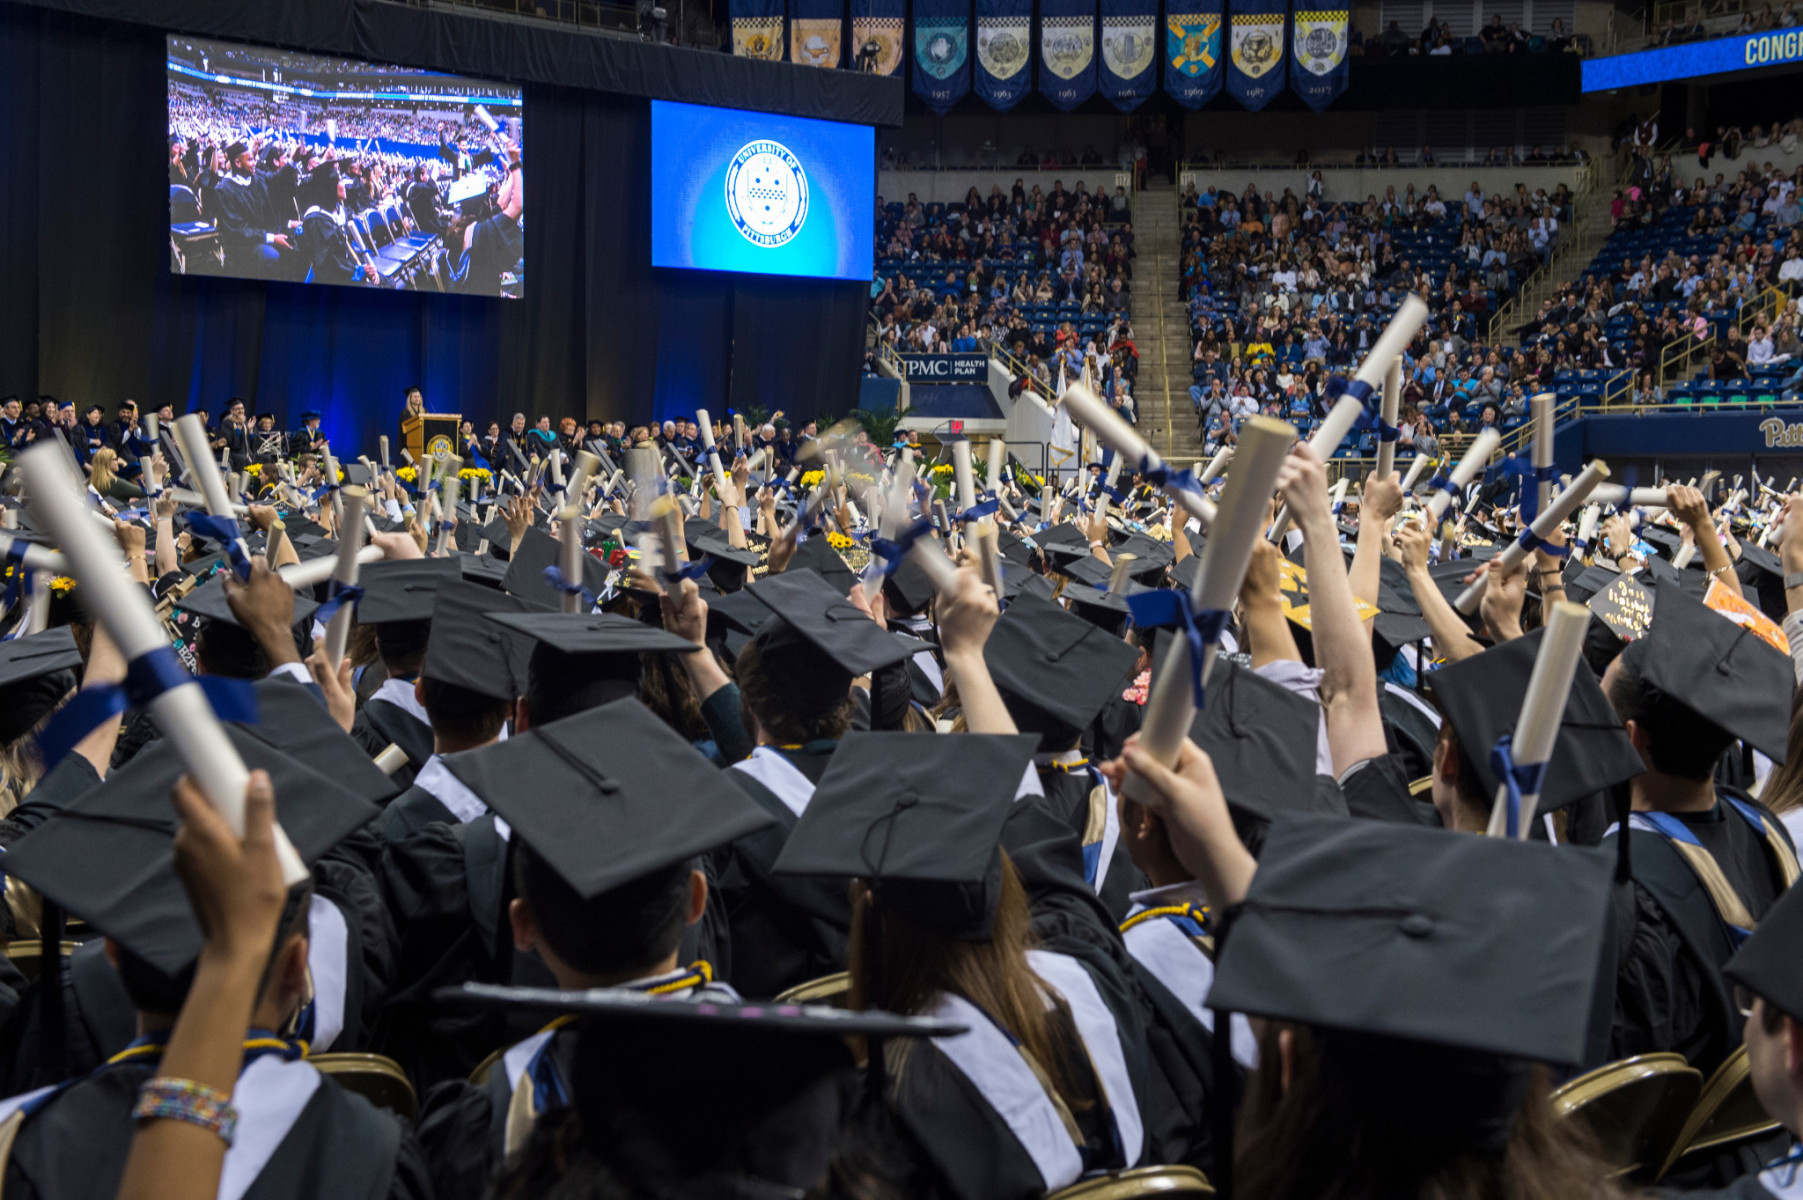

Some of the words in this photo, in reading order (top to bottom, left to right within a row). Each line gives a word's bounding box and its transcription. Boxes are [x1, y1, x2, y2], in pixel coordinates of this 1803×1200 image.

[1745, 31, 1803, 65] CONG
[932, 90, 950, 99] 1957
[993, 89, 1011, 99] 1963
[1246, 87, 1265, 98] 1987
[1309, 86, 1331, 95] 2017
[954, 360, 985, 368] HEALTH
